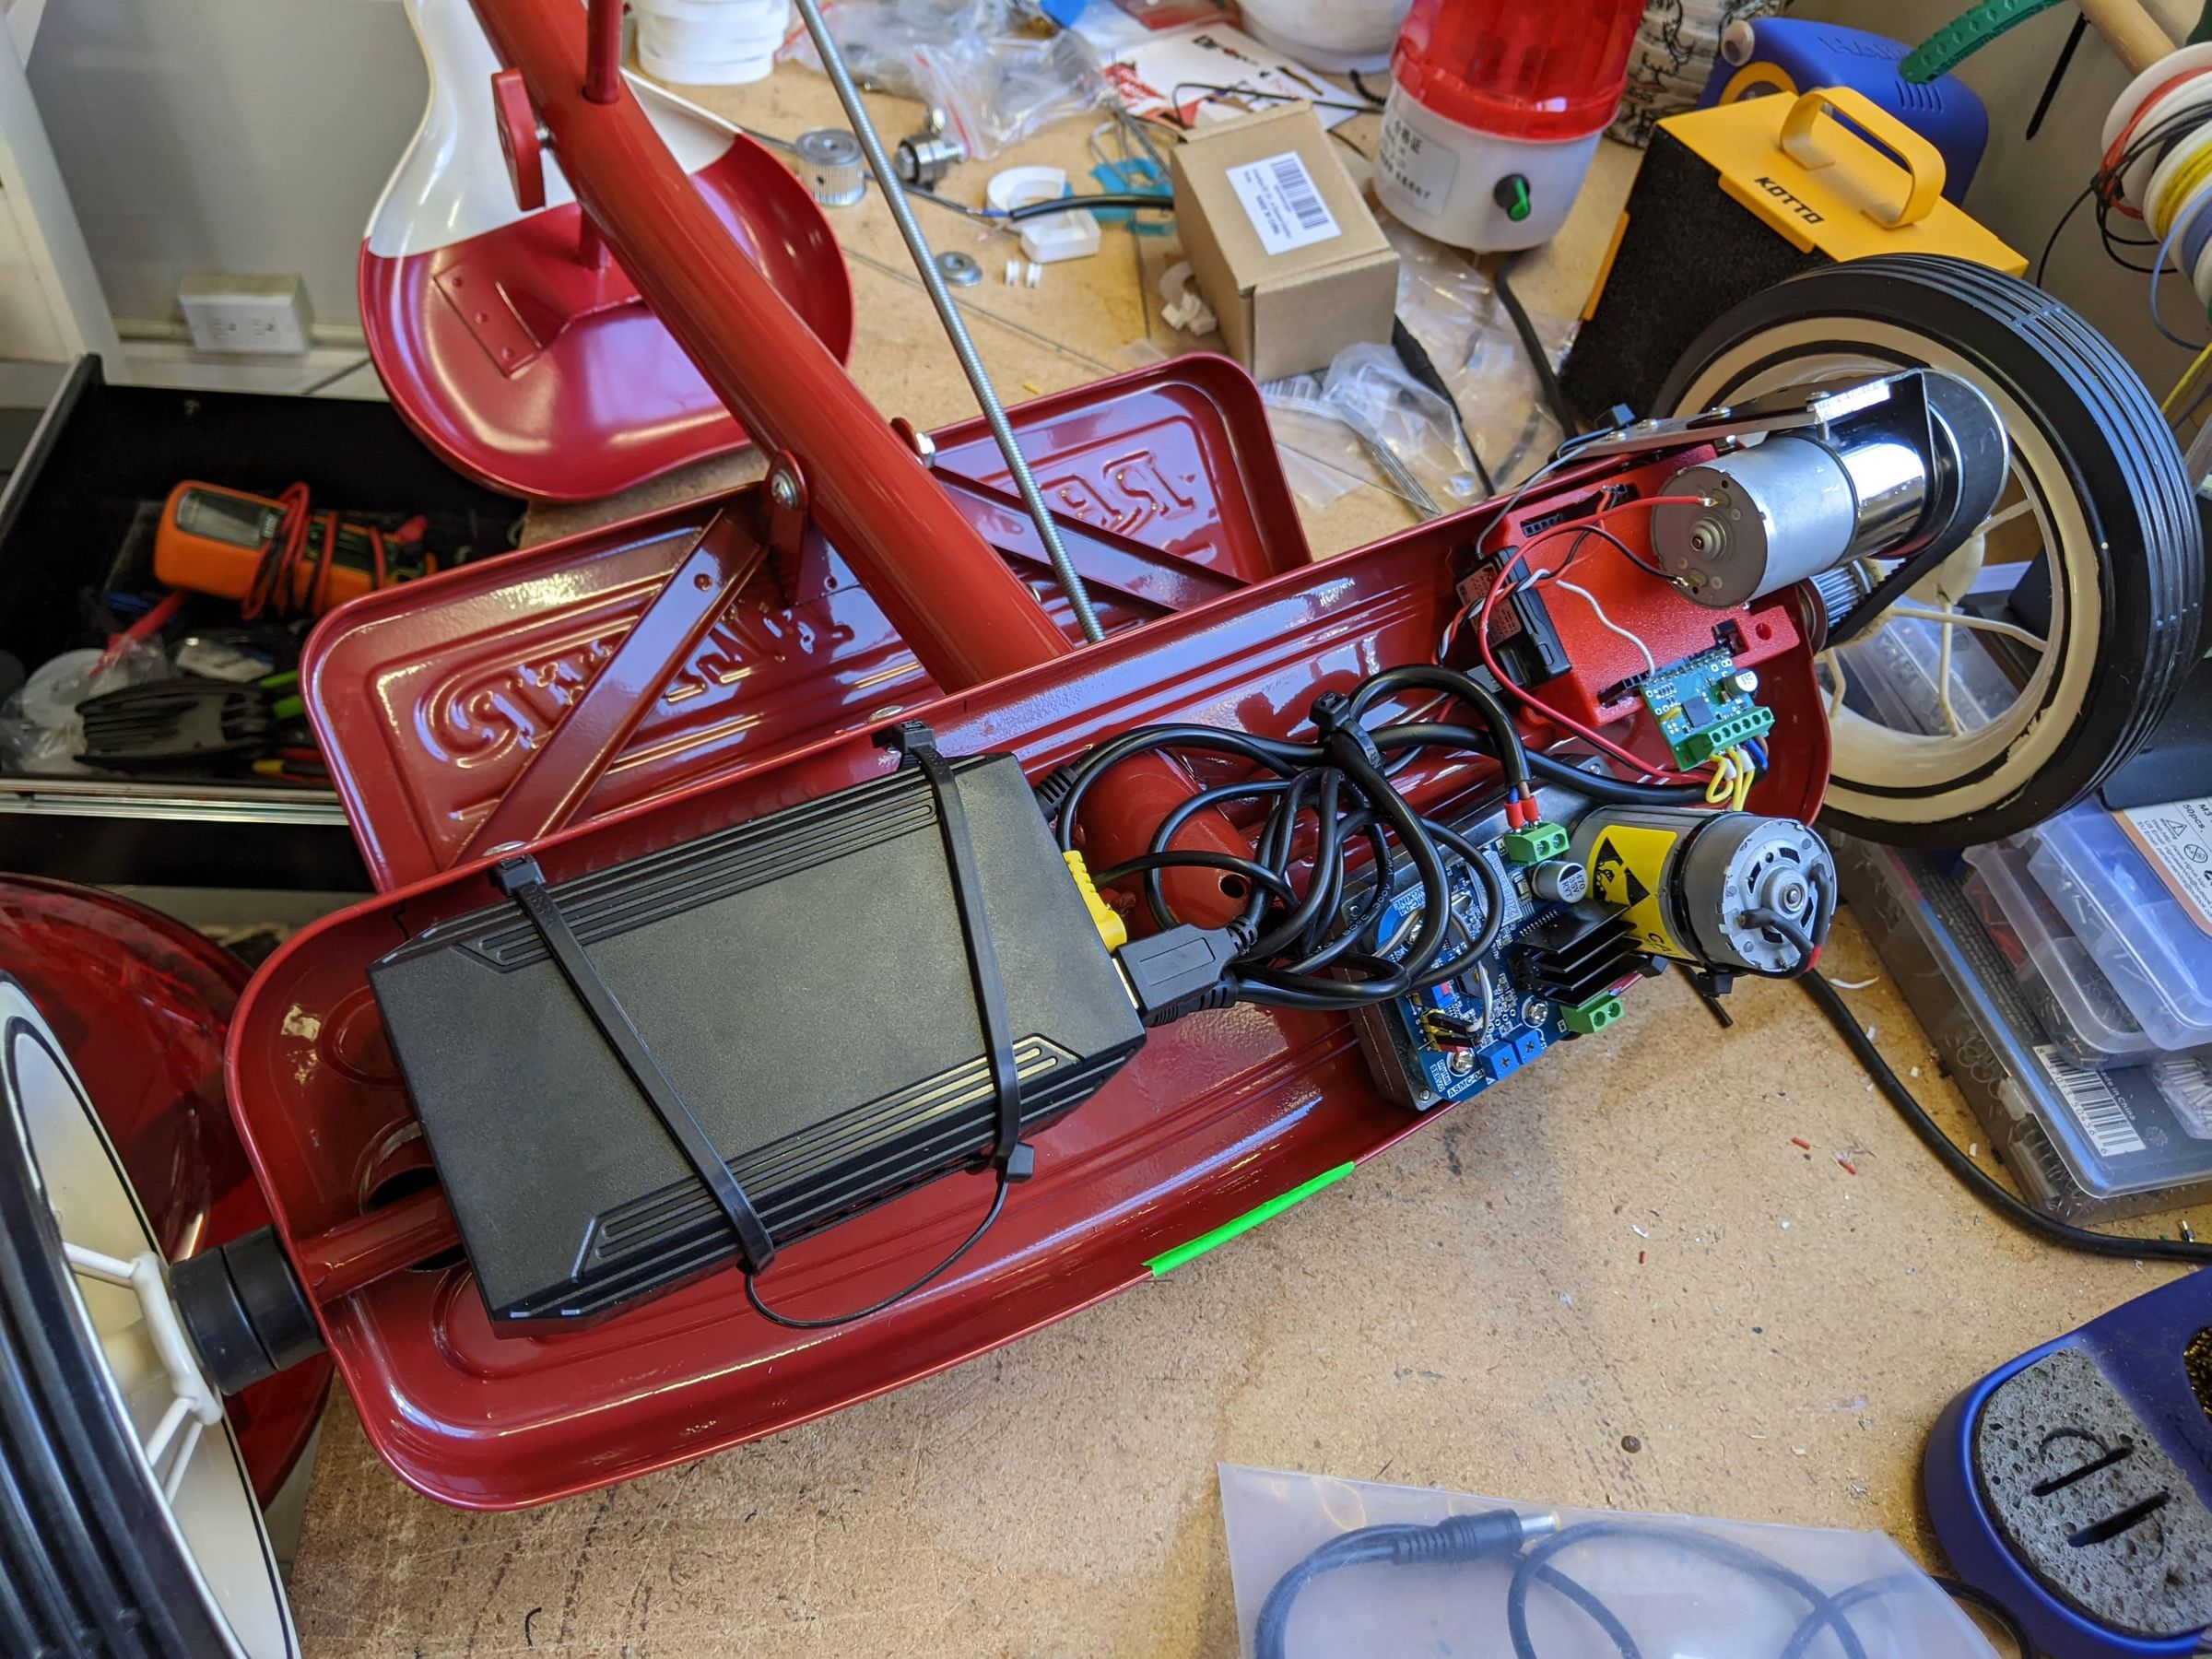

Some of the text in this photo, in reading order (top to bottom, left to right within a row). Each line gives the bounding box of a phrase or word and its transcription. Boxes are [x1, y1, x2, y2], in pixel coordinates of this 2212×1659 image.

[1753, 176, 1825, 224] KOTTO
[2183, 804, 2206, 832] 50pcs.
[1561, 881, 1573, 899] RVT
[1569, 877, 1580, 894] 35V
[1575, 873, 1586, 890] 470
[1372, 883, 1391, 909] 300V
[1393, 885, 1425, 911] NGXINE
[1401, 893, 1425, 915] MC-04
[1430, 1065, 1445, 1091] SERVO
[1438, 1059, 1451, 1085] Digital
[1448, 1068, 1486, 1098] ASMC-04
[2118, 1097, 2136, 1121] China
